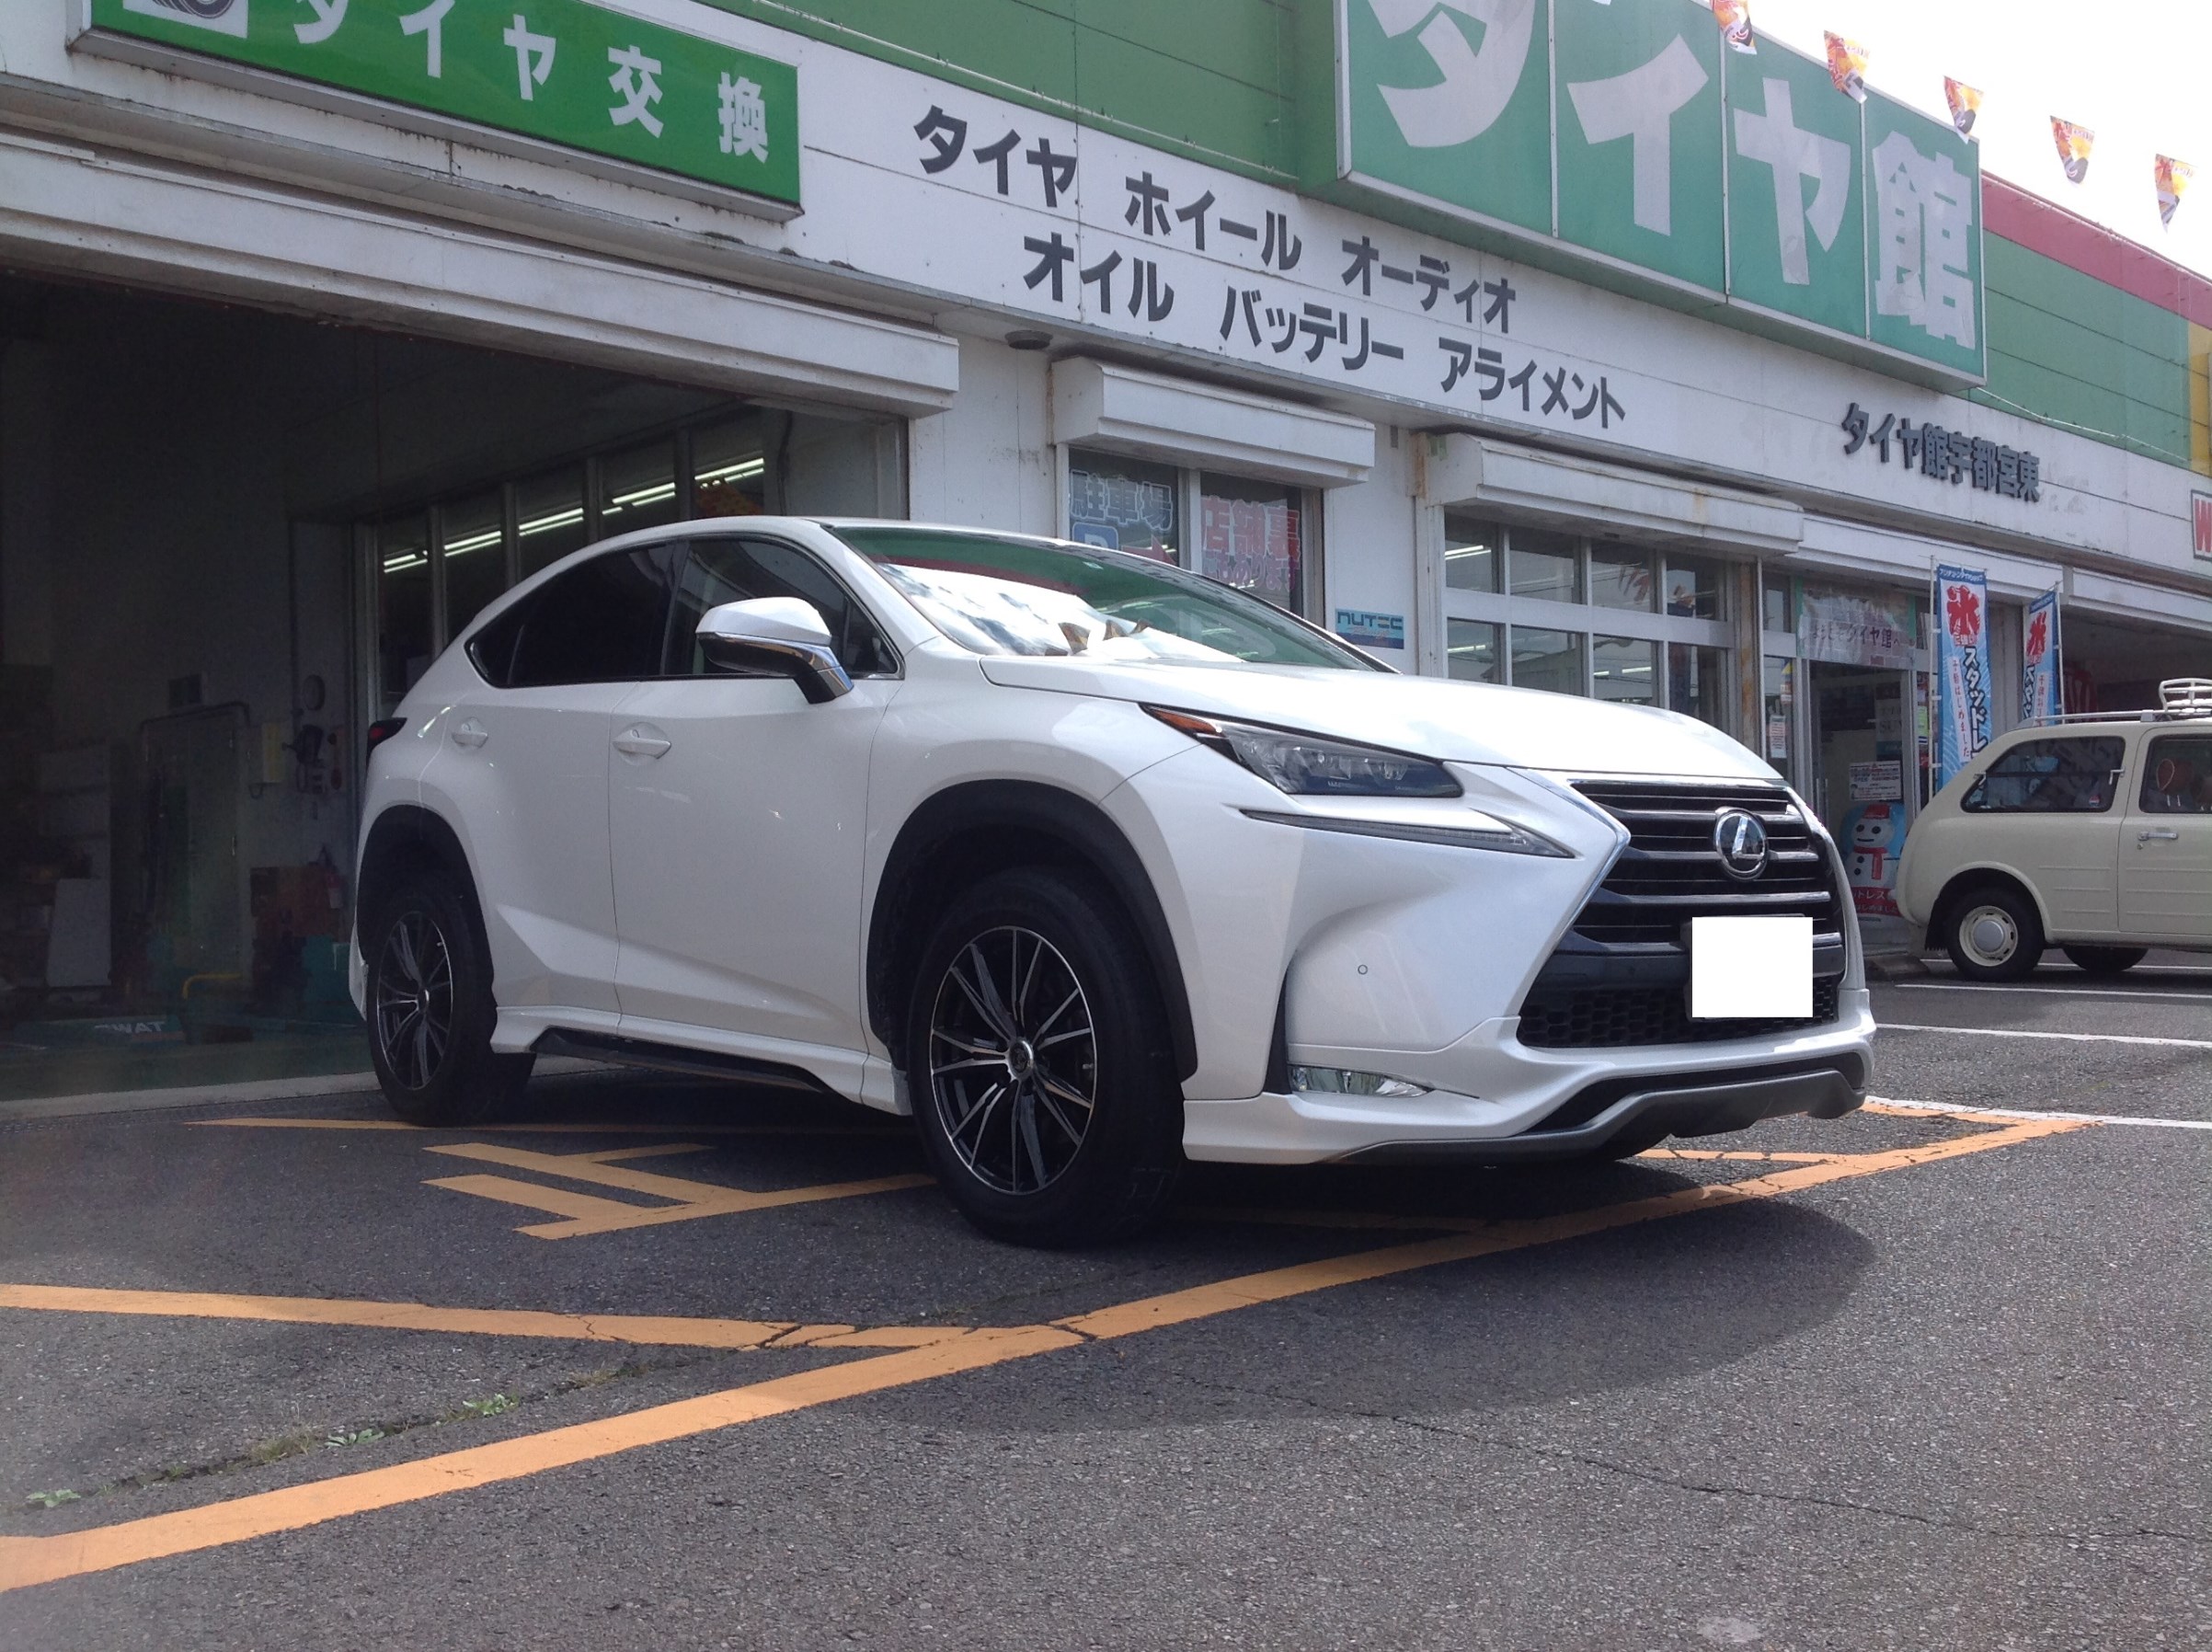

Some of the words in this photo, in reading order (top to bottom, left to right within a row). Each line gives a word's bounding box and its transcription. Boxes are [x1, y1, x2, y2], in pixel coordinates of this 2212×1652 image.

[913, 105, 1077, 208] タイヤ
[1124, 171, 1302, 271] ホイール
[1341, 235, 1517, 334] オーディオ
[1367, 0, 1976, 350] タイヤ館
[1022, 232, 1175, 323] オイル
[1220, 284, 1404, 371] バッテリー
[1438, 336, 1626, 429] アライメント
[1070, 468, 1174, 531] 駐車場
[1840, 402, 2041, 503] タイヤ館宇都宮東
[1945, 584, 1981, 637] 氷
[1963, 646, 1989, 760] スタッドレ
